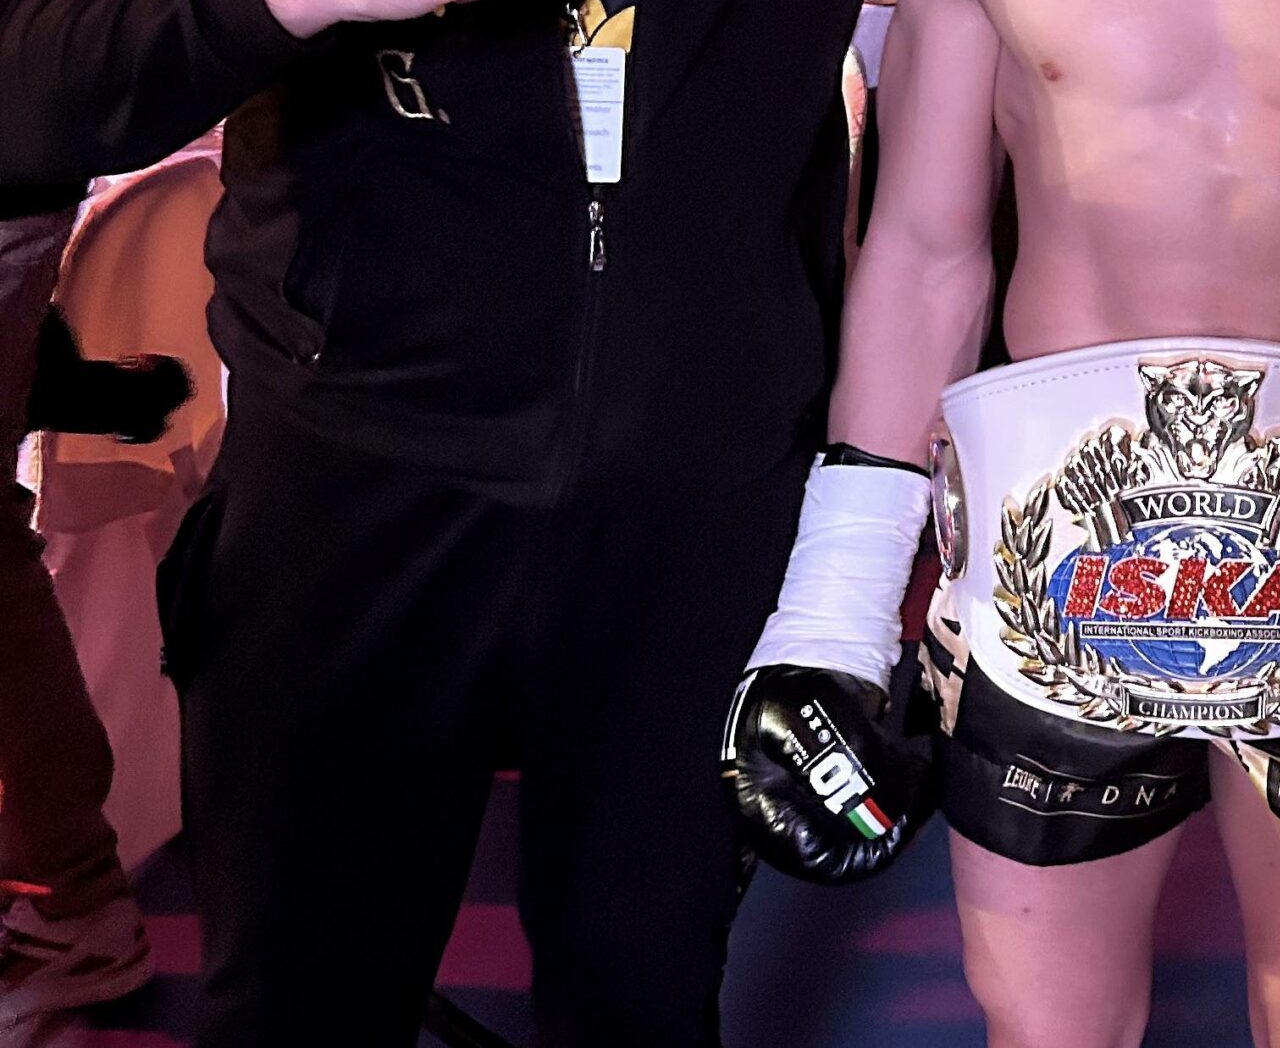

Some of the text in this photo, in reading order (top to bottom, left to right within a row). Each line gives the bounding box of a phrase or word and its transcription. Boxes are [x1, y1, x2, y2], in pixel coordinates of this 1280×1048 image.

[1133, 492, 1257, 520] WORLD
[1083, 625, 1154, 637] INTERNATIONAL
[1156, 627, 1186, 637] SPORT
[1188, 628, 1243, 639] KICKBOXING
[1138, 701, 1245, 721] CHAMPION
[809, 751, 870, 816] 10
[1002, 764, 1042, 800] LEONE
